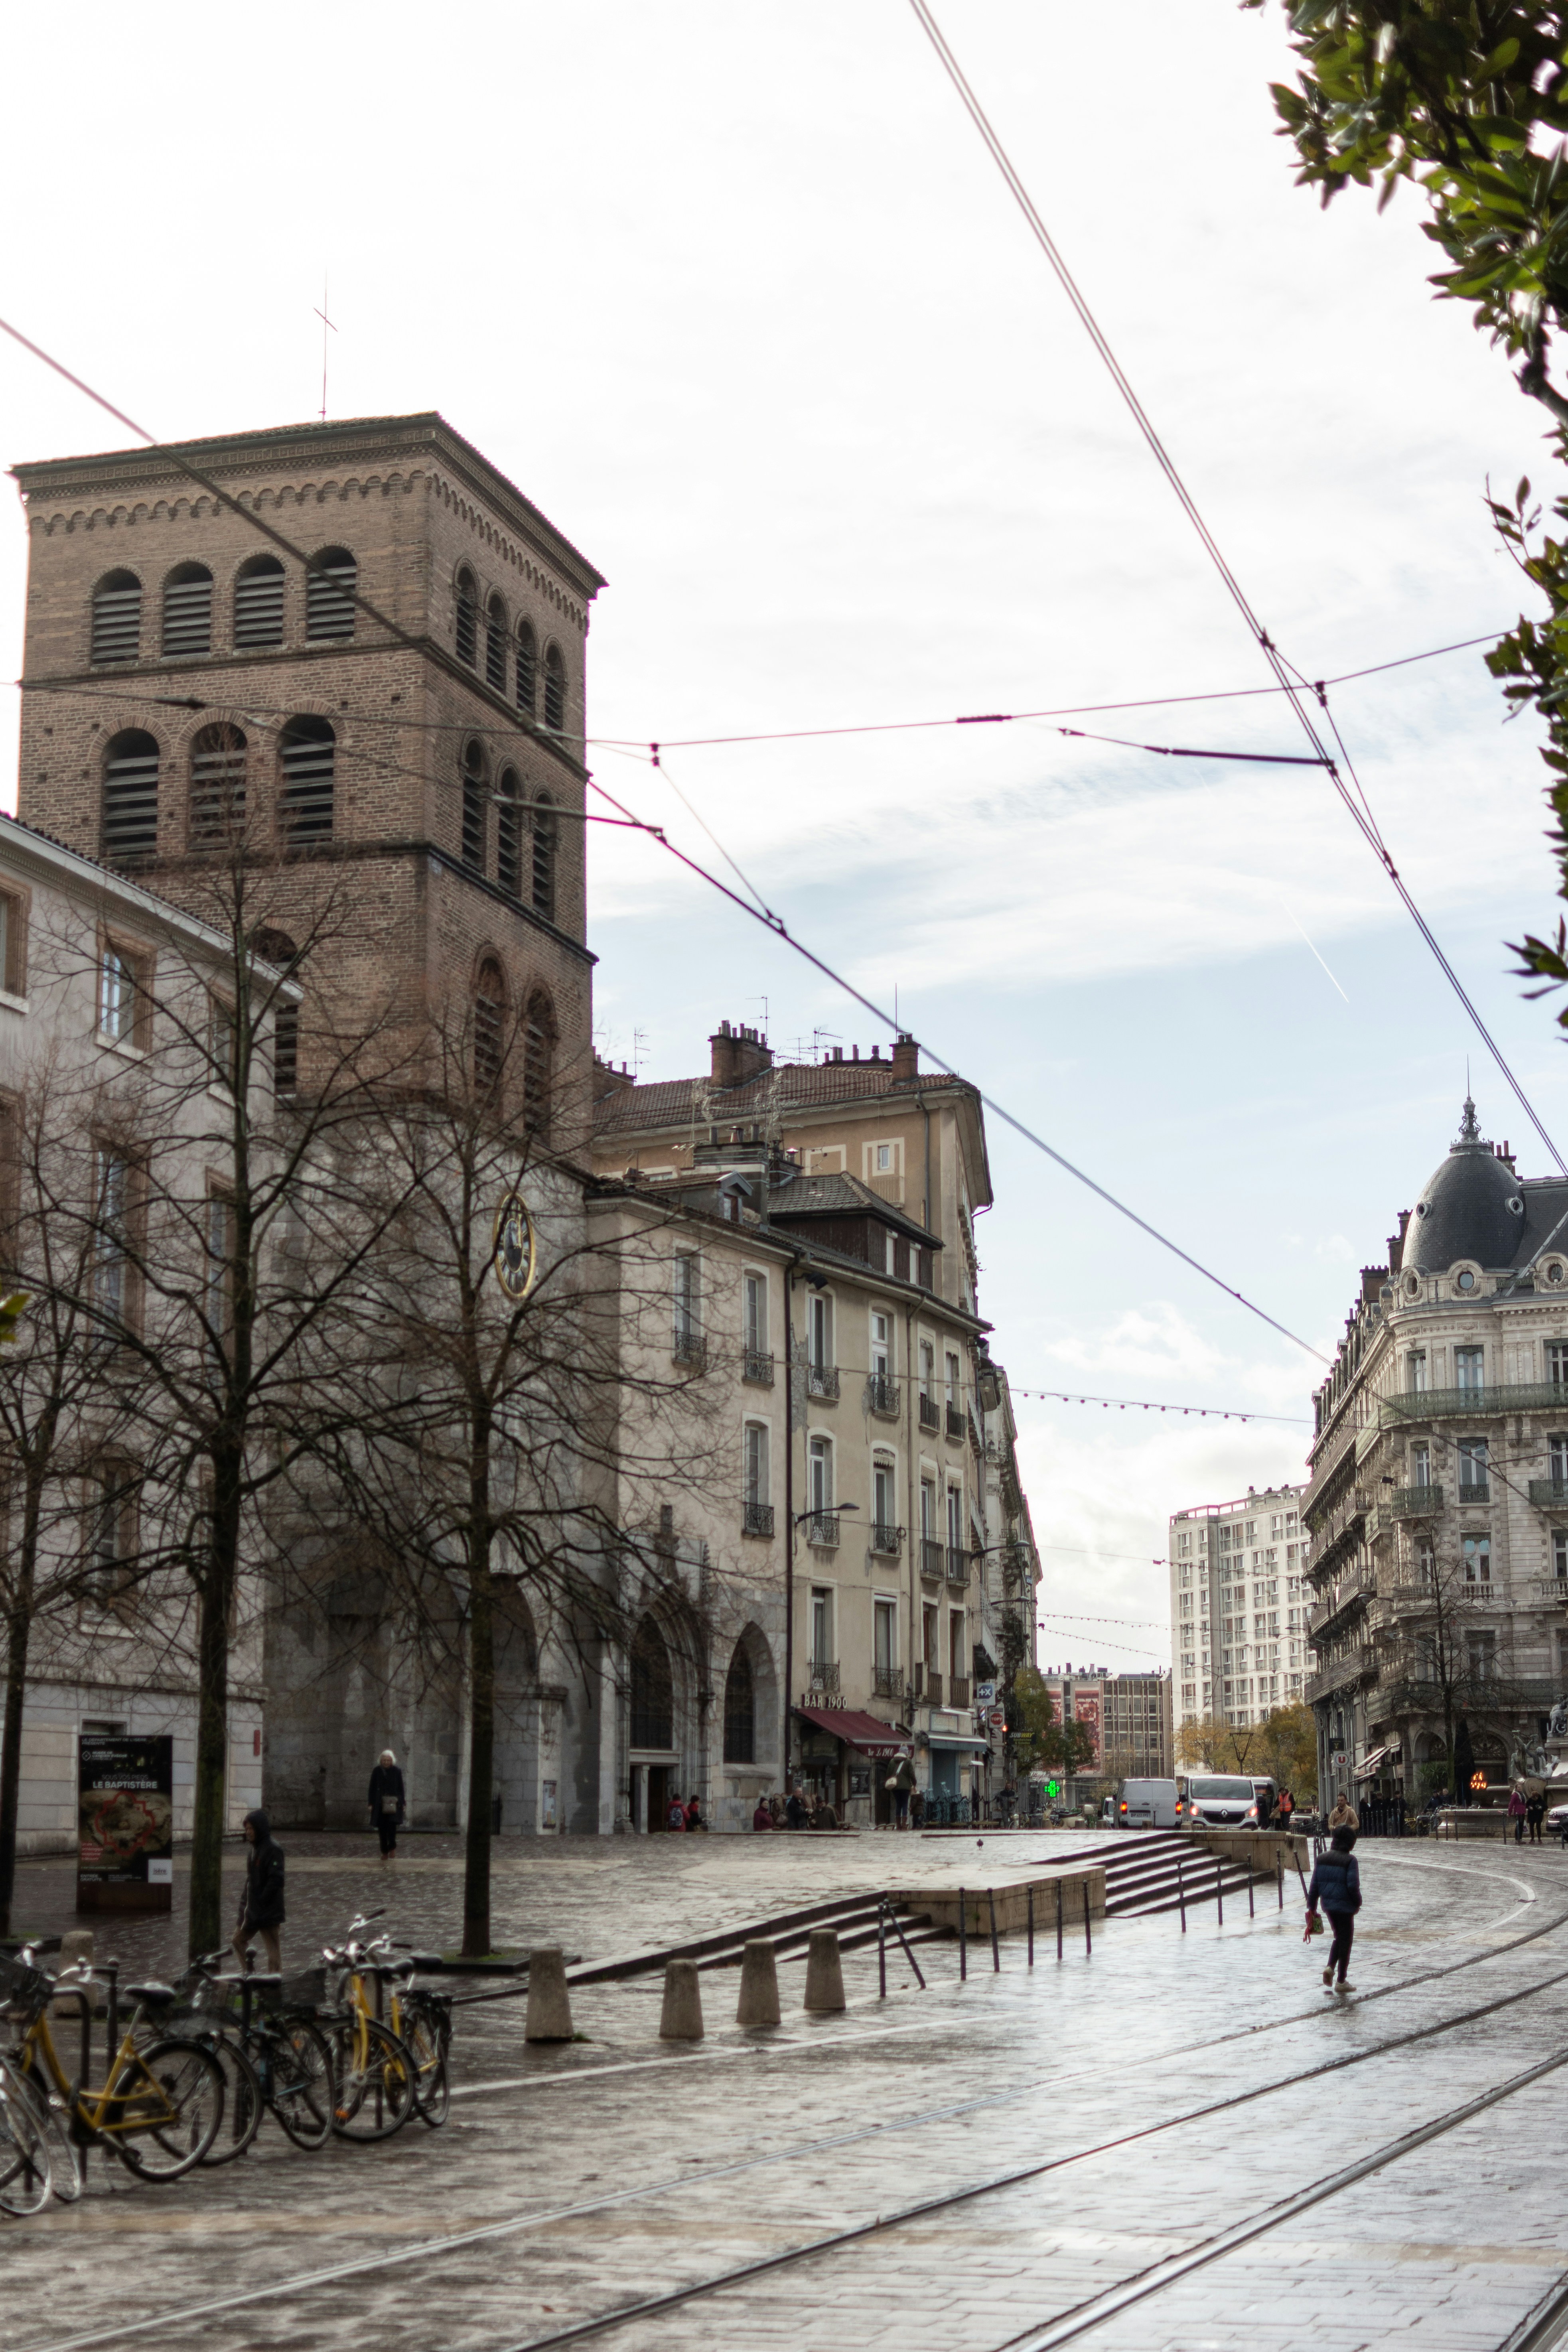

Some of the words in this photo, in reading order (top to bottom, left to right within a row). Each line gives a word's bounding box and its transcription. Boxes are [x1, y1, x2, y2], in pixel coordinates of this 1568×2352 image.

[804, 1695, 822, 1707] BAR
[828, 1696, 847, 1709] 1900
[882, 1747, 894, 1757] 1900
[105, 1780, 158, 1789] BAPTISTÈRE
